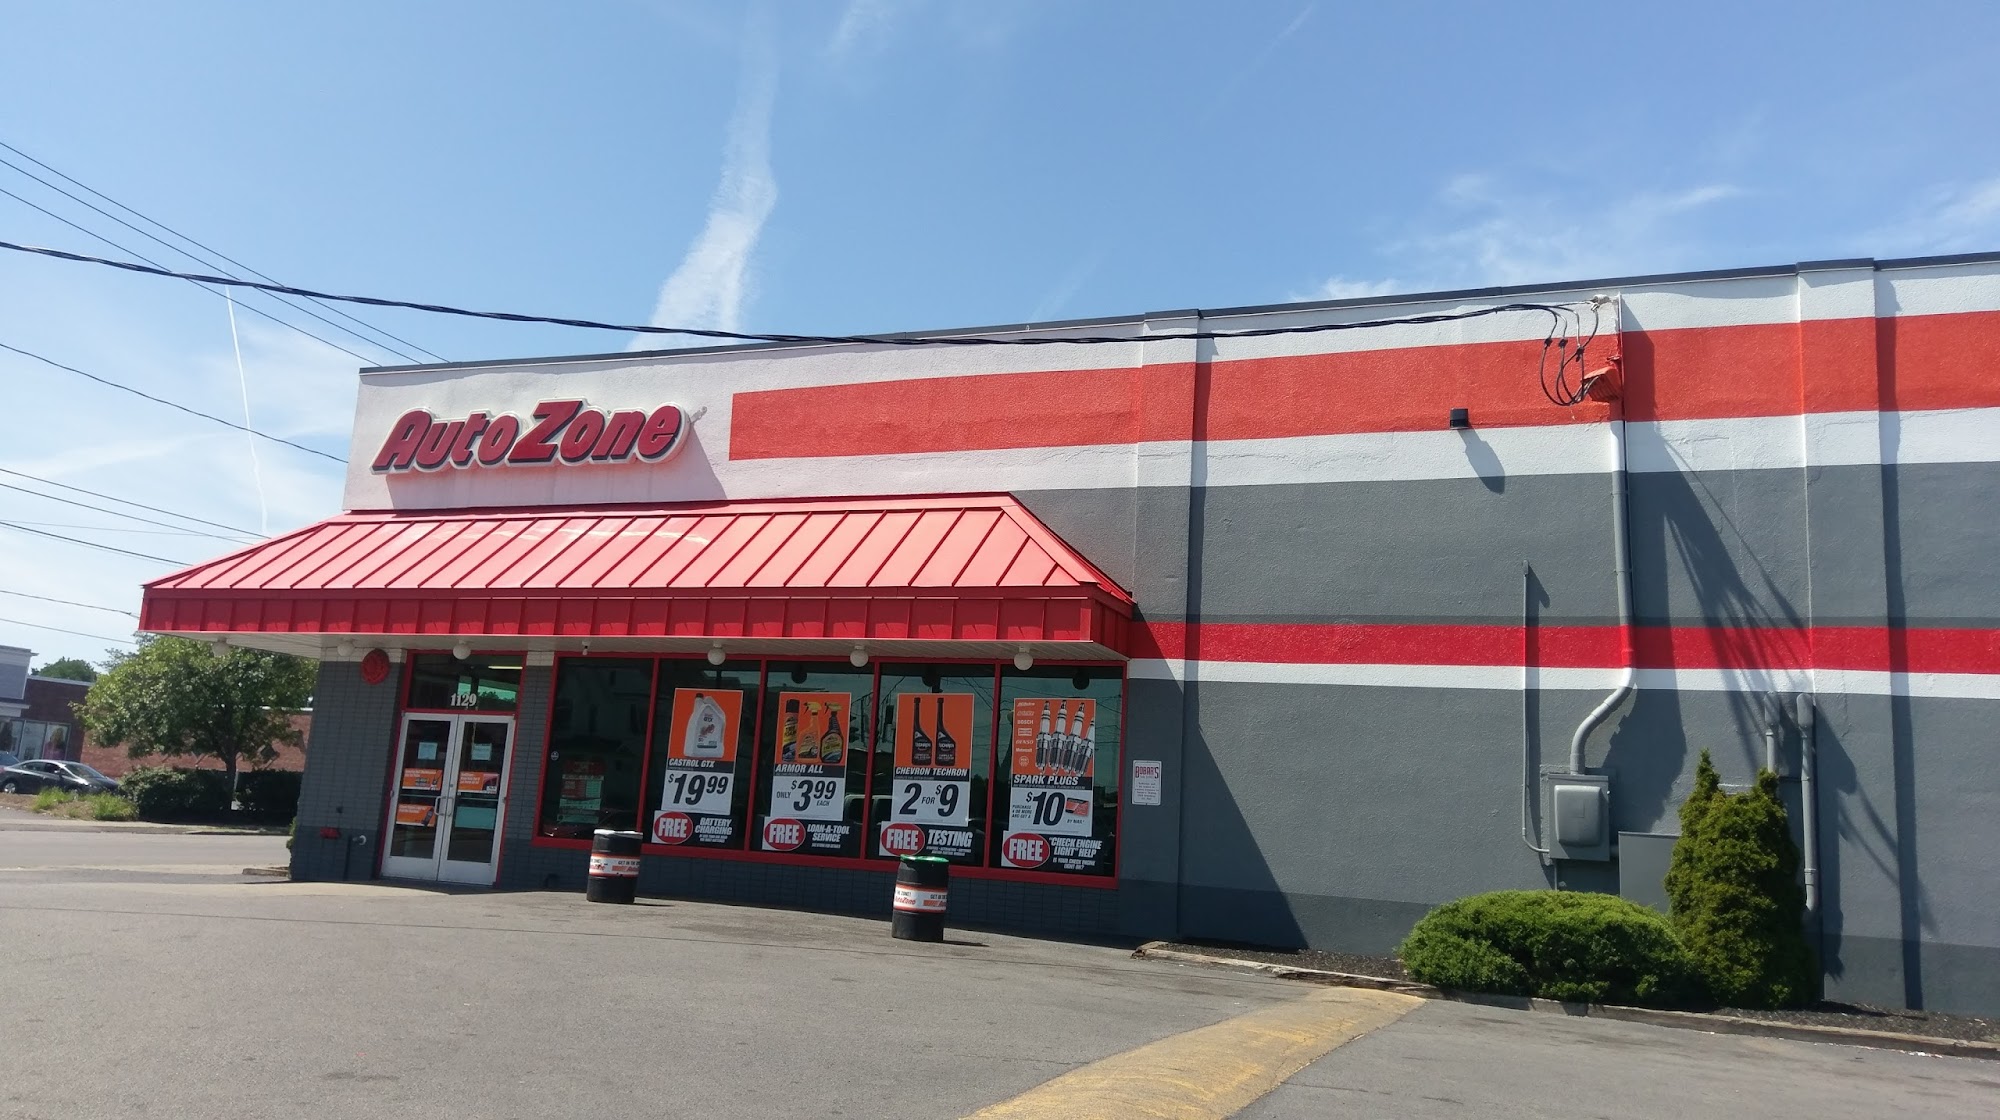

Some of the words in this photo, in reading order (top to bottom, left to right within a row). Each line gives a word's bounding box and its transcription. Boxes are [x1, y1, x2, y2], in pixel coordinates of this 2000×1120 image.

[371, 399, 686, 473] AutoZone
[450, 693, 477, 706] 1129
[669, 758, 699, 767] CASTROL
[776, 764, 806, 773] ARMOR
[808, 765, 824, 774] ALL
[896, 767, 932, 775] CHEVRON
[932, 768, 968, 776] TECHRON
[1014, 774, 1046, 784] SPARK
[1047, 776, 1079, 786] PLUGS
[899, 783, 922, 815] 2
[935, 784, 959, 817] $9
[1026, 791, 1065, 826] $10
[658, 817, 688, 838] FREE
[700, 817, 732, 827] BATTERY
[694, 826, 732, 835] CHARGING
[768, 824, 799, 844] FREE
[807, 824, 850, 834] LOAN-A-TOOL
[812, 833, 841, 842] SERVICE
[886, 828, 918, 850] FREE
[928, 829, 973, 848] TESTING
[1009, 839, 1043, 861] FREE
[1076, 840, 1102, 849] ENGINE
[1078, 848, 1096, 858] HELP
